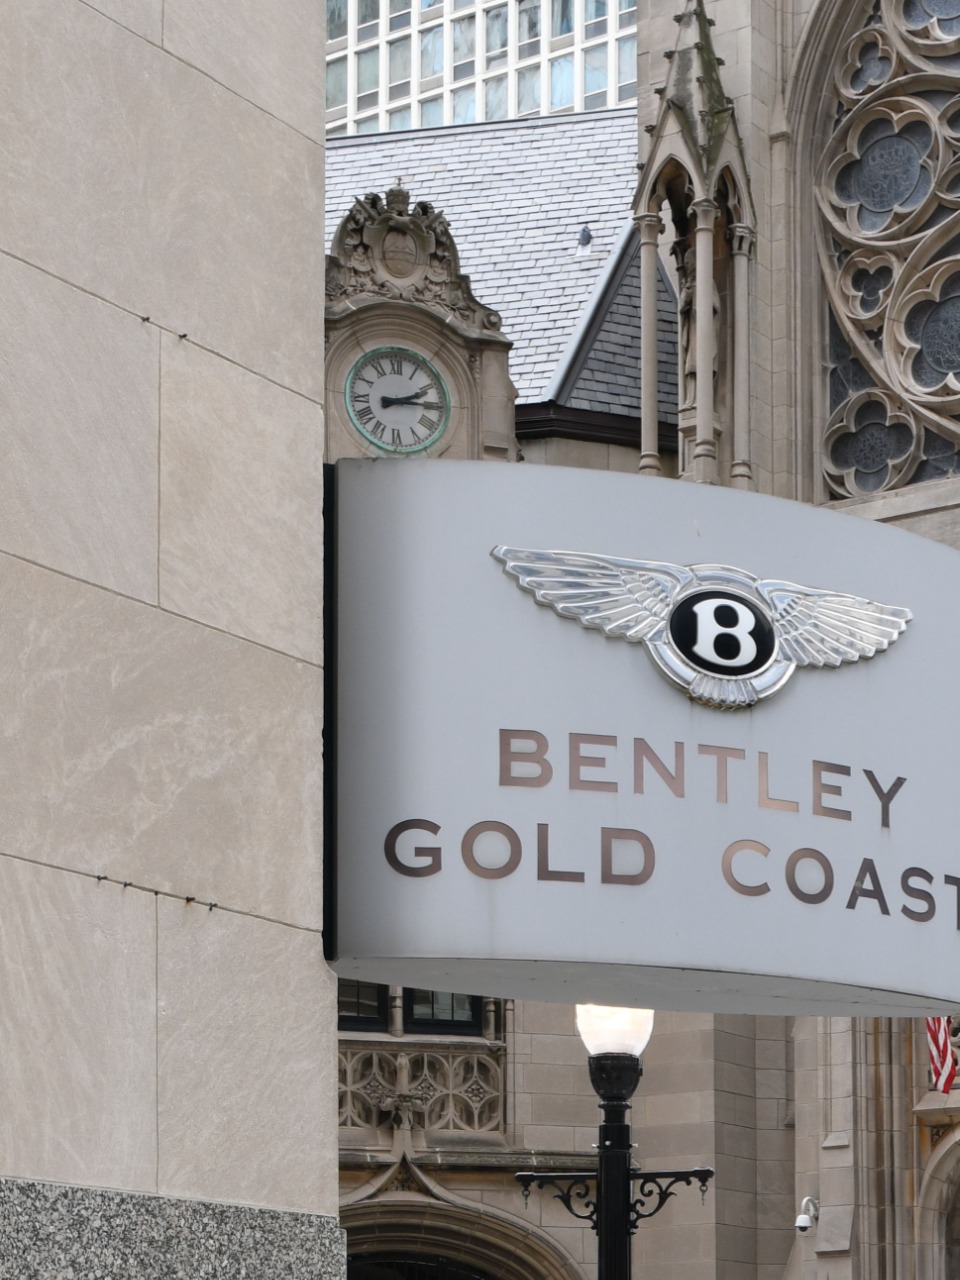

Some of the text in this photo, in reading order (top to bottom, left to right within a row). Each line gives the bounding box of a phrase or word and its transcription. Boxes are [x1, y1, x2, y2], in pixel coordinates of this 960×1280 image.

[371, 361, 387, 379] XI
[389, 359, 403, 376] XII
[358, 377, 374, 388] X
[354, 393, 370, 404] IX
[356, 406, 376, 426] VIII
[371, 420, 387, 440] VII
[391, 428, 402, 445] VI
[409, 426, 421, 441] V
[690, 596, 758, 669] B
[498, 728, 908, 829] BENTLEY
[383, 818, 656, 886] GOLD
